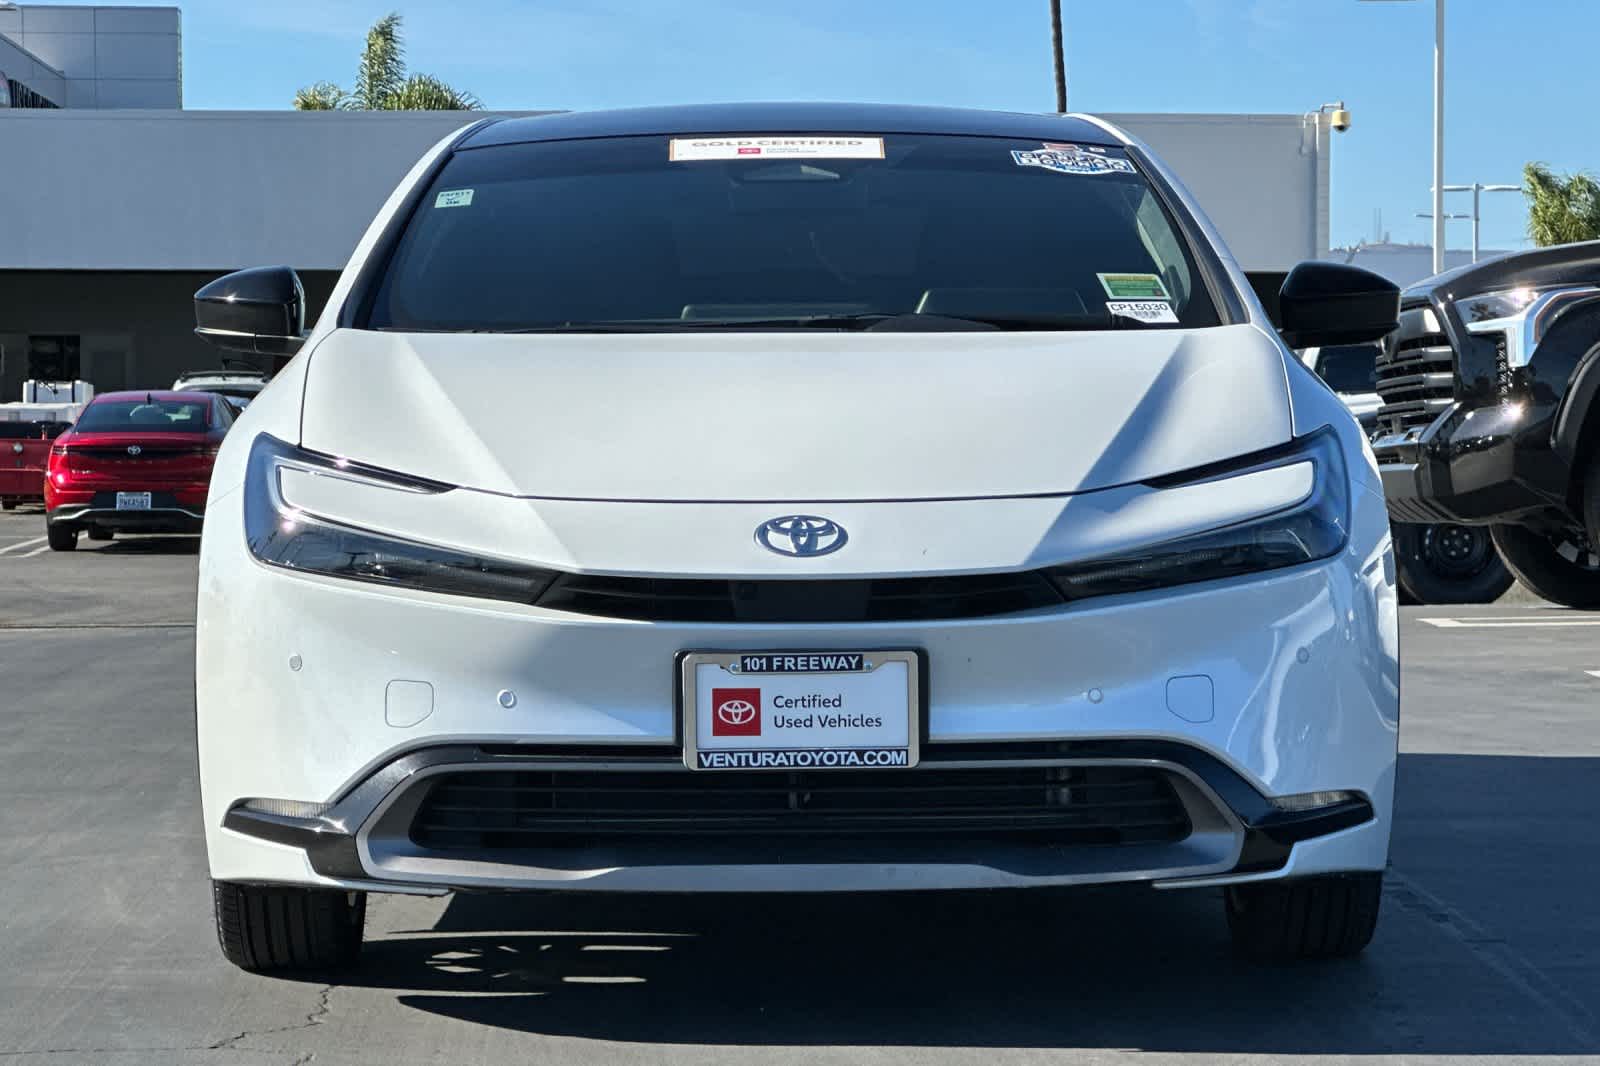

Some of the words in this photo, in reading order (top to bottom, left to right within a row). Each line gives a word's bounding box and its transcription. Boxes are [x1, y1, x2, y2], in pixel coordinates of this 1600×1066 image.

[1110, 303, 1169, 311] CP15030
[743, 657, 767, 671] 101
[773, 656, 860, 671] FREEWAY
[773, 694, 842, 709] Certified
[774, 714, 813, 729] Used
[818, 714, 882, 728] Vehicles
[699, 750, 907, 768] VENTURATOYOTA.COM
